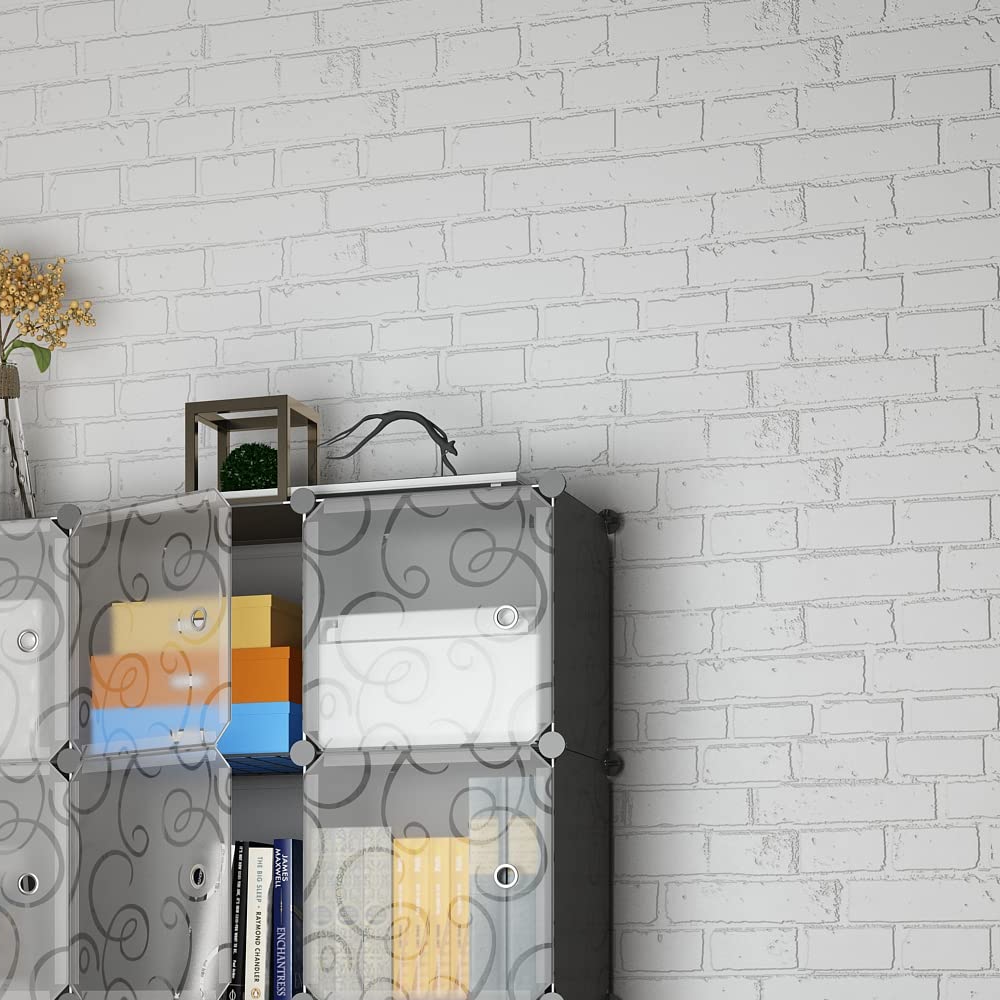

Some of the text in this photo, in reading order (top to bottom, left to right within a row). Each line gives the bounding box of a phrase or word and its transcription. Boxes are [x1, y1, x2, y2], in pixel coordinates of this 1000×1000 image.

[274, 848, 282, 889] MAXWELL
[281, 854, 289, 882] JAMES
[253, 948, 261, 983] CHANDLER
[276, 927, 286, 997] ENCHANTRESS
